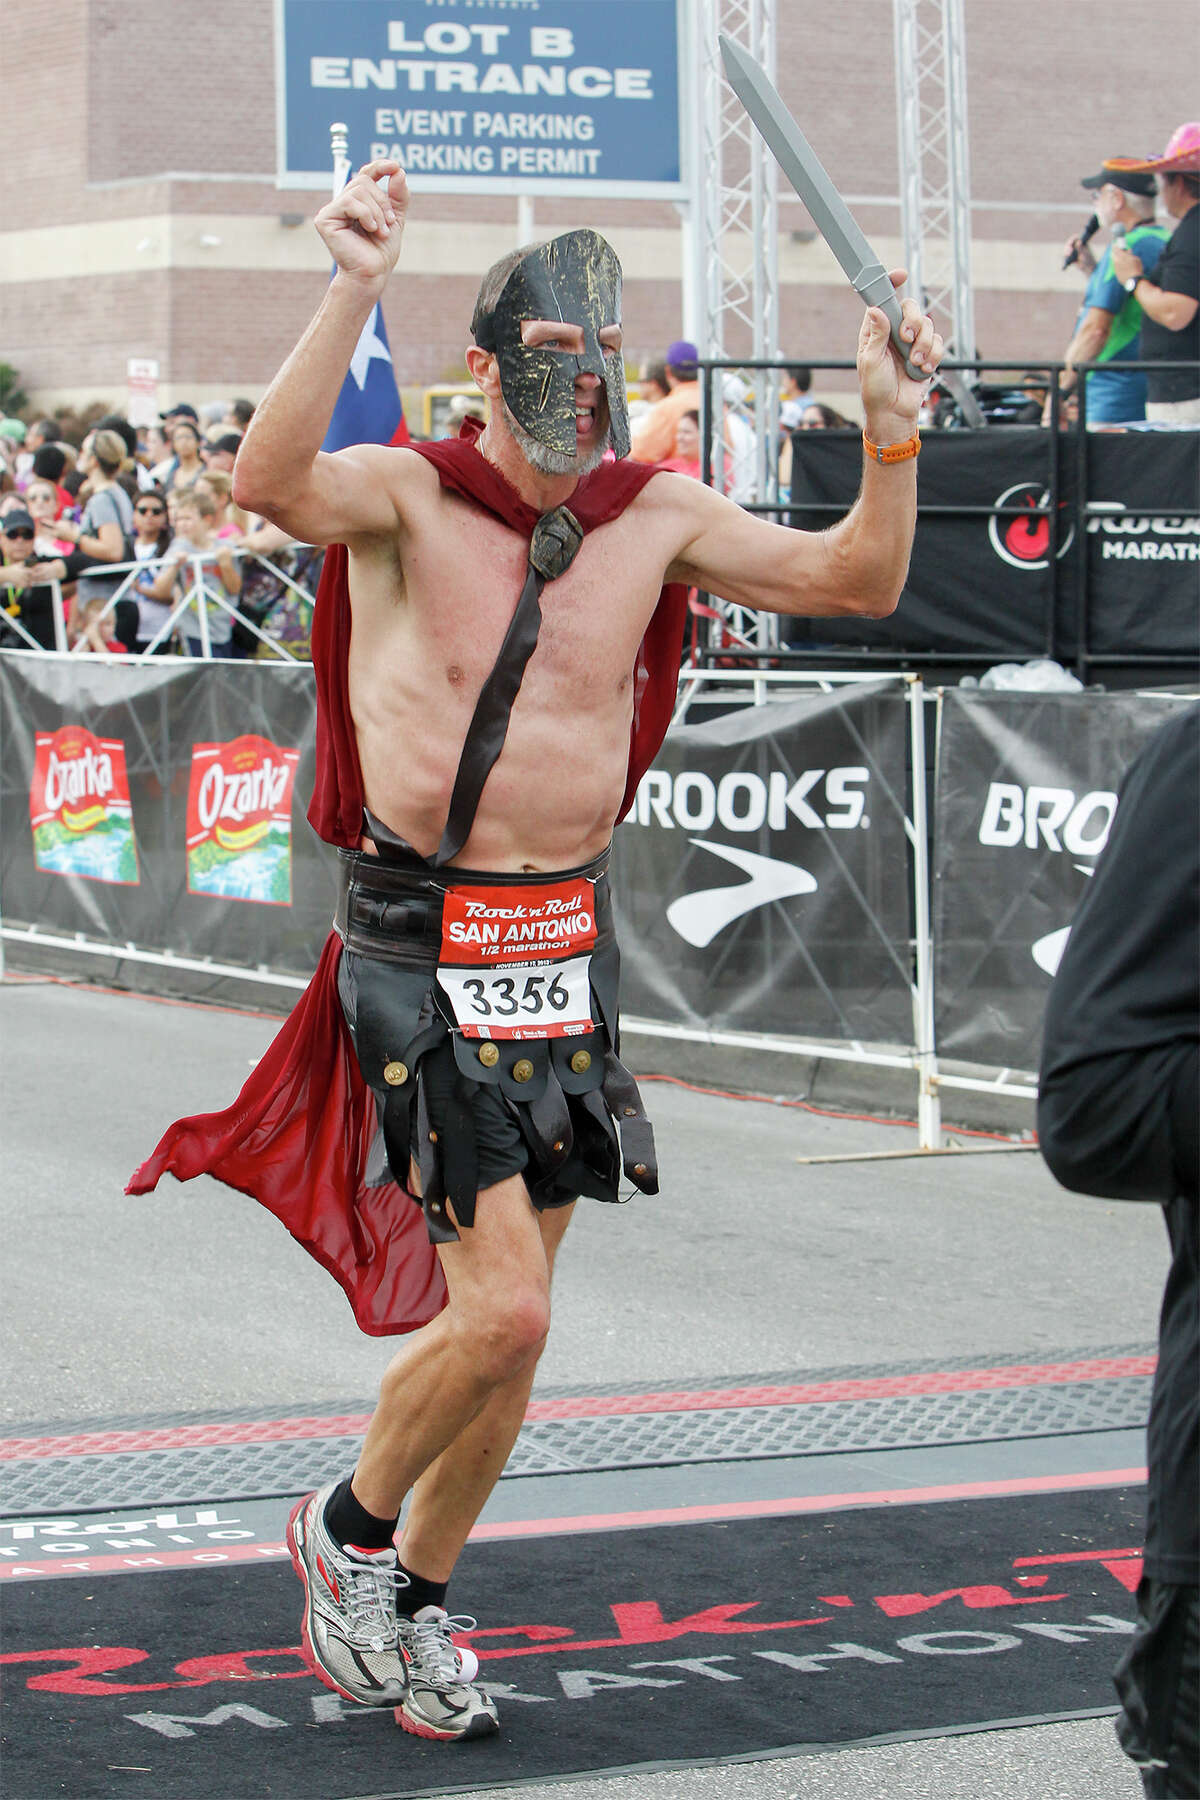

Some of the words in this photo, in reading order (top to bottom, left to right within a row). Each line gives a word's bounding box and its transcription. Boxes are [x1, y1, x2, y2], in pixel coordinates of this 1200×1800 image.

[387, 20, 510, 56] LOT
[530, 26, 576, 58] B
[310, 56, 655, 99] ENTRANCE
[375, 108, 467, 137] EVENT
[473, 112, 595, 141] PARKING
[370, 142, 495, 172] PARKING
[501, 146, 602, 174] PERMIT
[45, 747, 113, 811] Ozarka
[198, 758, 289, 829] Ozarka
[623, 766, 870, 832] ROOKS
[979, 781, 1119, 856] BRO
[464, 901, 527, 919] Rock
[545, 895, 582, 915] Roll
[449, 921, 500, 944] SAN
[502, 911, 592, 942] ANTONIO
[480, 944, 499, 956] 1/2
[503, 940, 570, 954] marathon
[462, 971, 569, 1016] 3356
